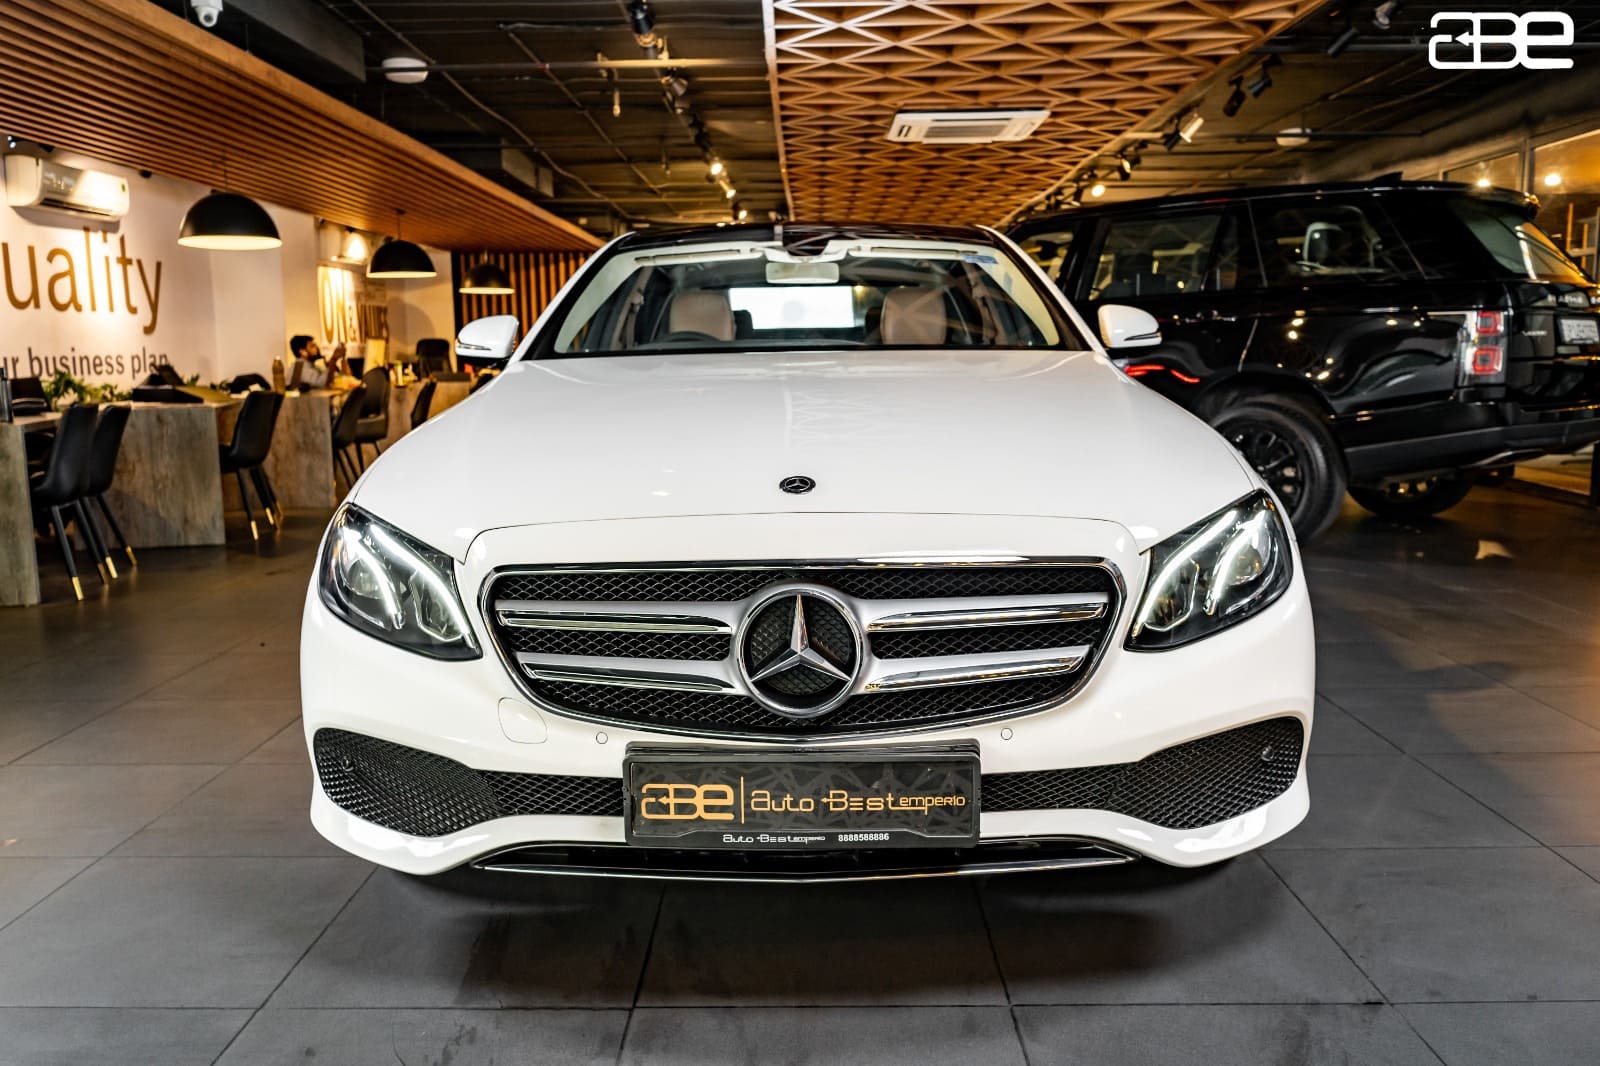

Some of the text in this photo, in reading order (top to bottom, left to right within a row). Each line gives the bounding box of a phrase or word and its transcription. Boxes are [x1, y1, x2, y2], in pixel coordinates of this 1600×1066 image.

[1, 225, 163, 335] uality
[28, 346, 125, 378] business
[131, 346, 169, 380] plan
